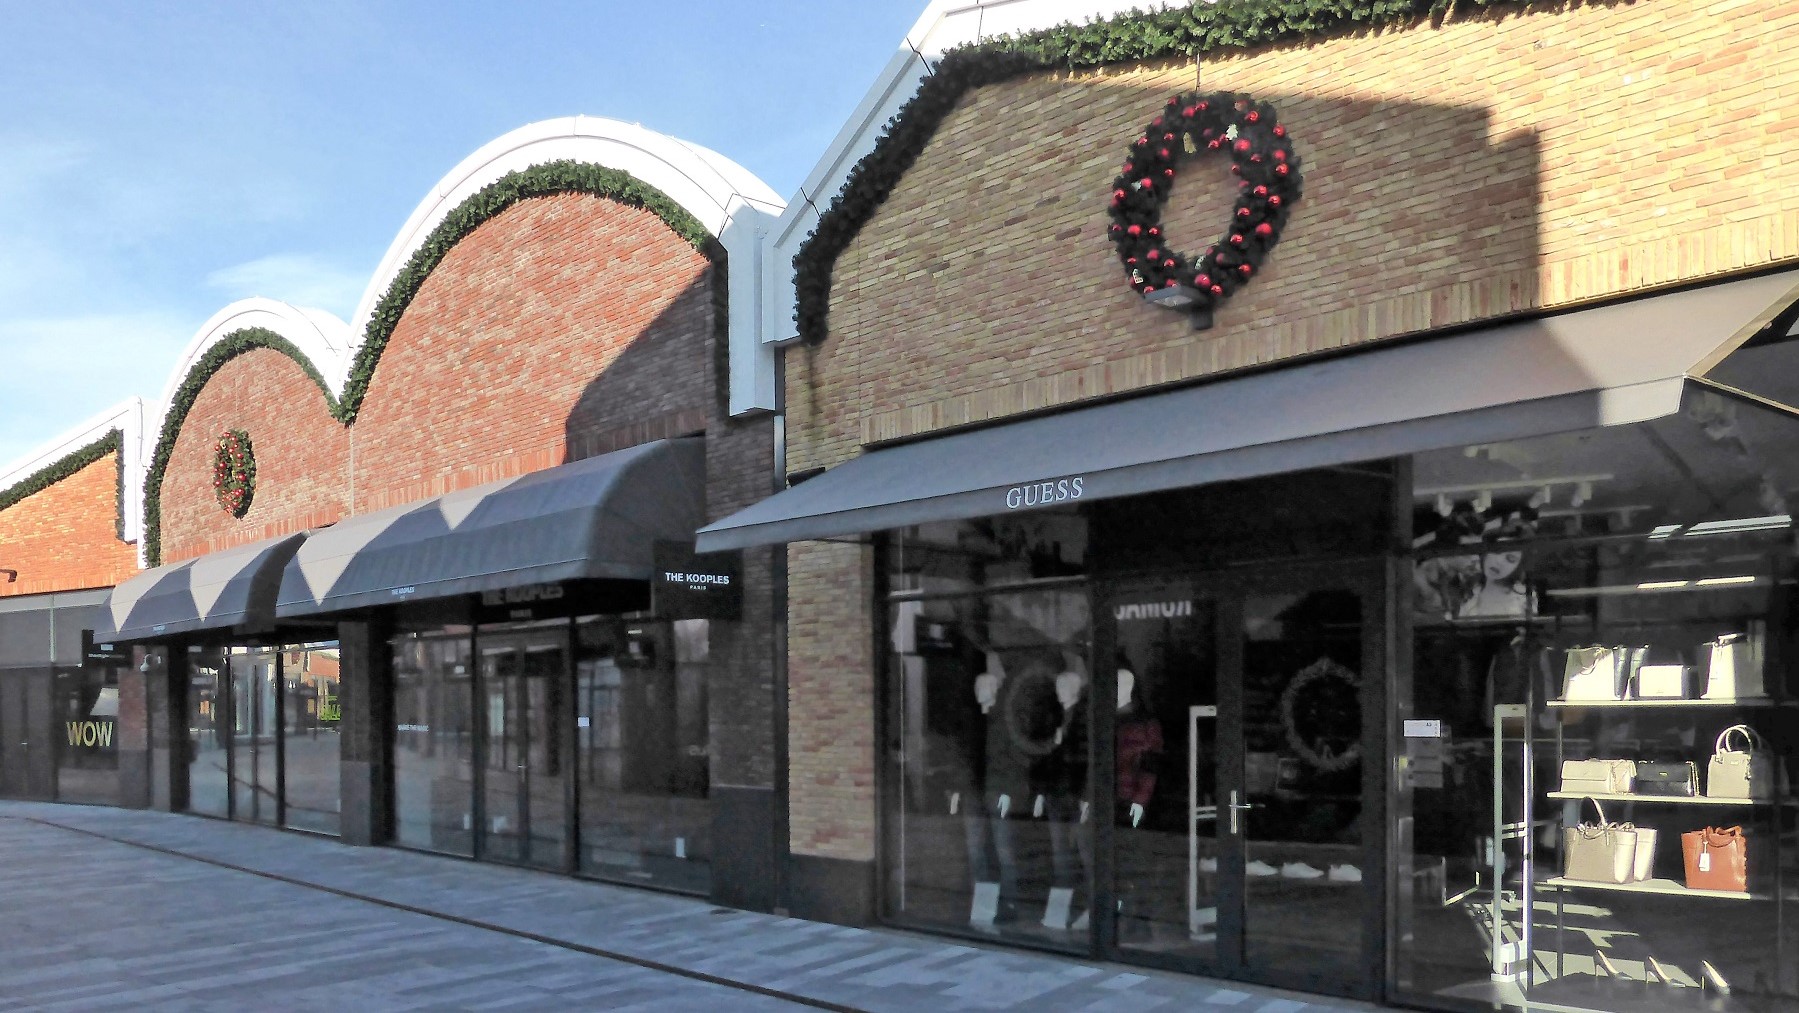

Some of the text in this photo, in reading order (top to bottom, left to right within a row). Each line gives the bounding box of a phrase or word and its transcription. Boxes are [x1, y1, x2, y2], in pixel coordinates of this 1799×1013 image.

[1006, 477, 1083, 509] GUESS
[665, 572, 730, 585] THE KOOPLES
[66, 721, 113, 747] WOW
